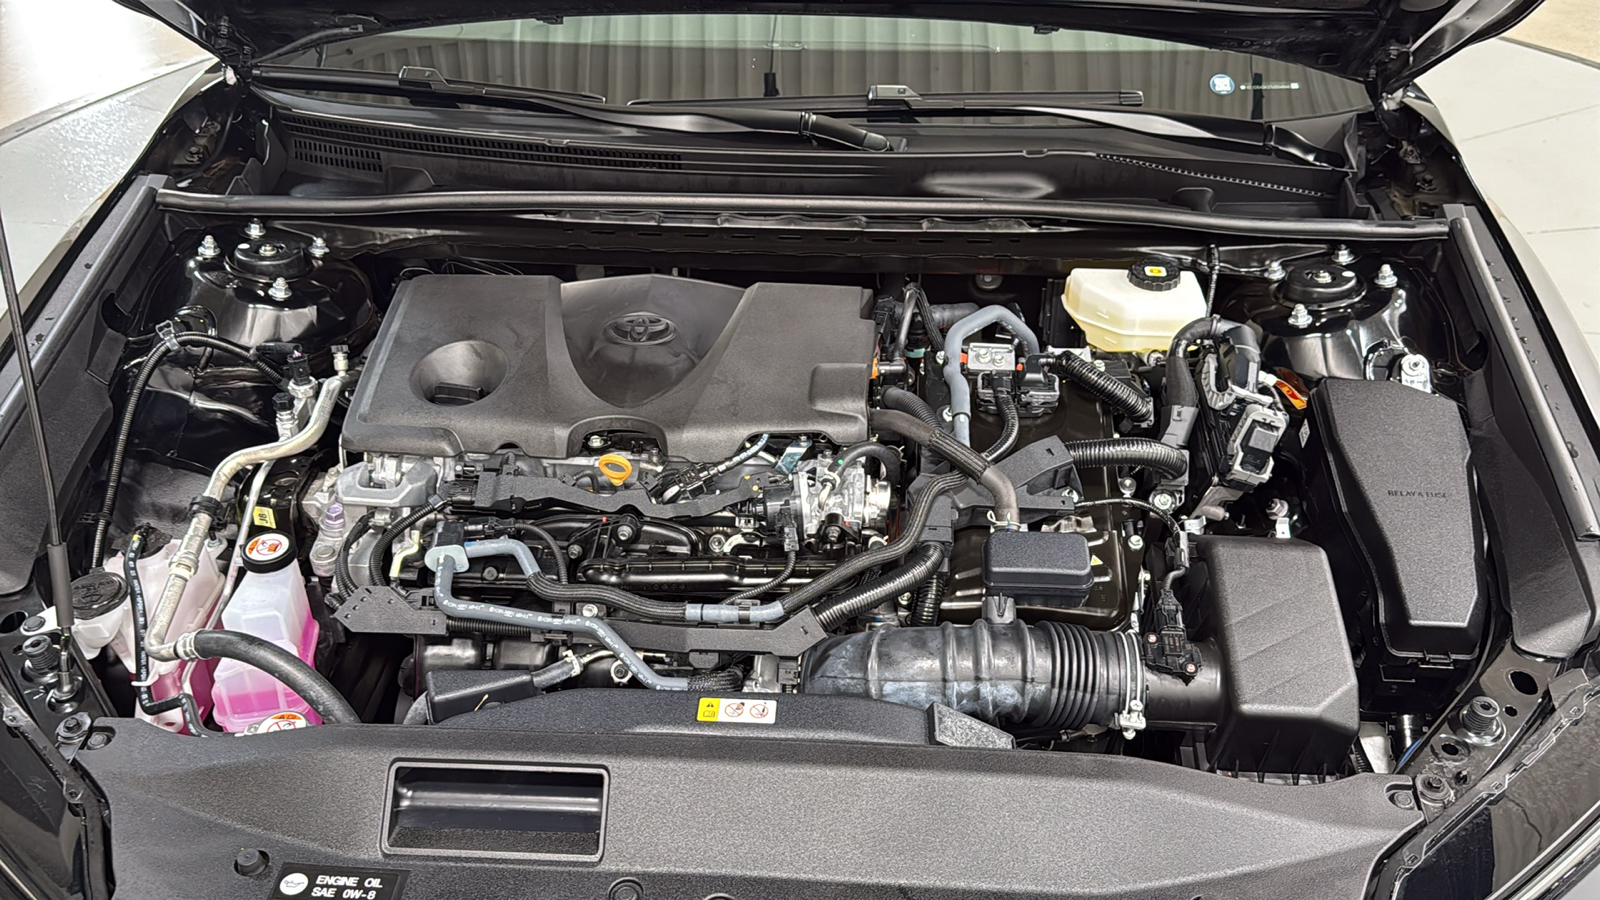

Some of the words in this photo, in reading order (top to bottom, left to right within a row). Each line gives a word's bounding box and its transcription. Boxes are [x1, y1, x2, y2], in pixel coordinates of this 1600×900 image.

[257, 513, 269, 524] J8
[315, 875, 360, 887] ENGINE
[364, 878, 384, 888] OIL
[311, 887, 337, 898] SAE
[342, 889, 376, 900] 0W-8
